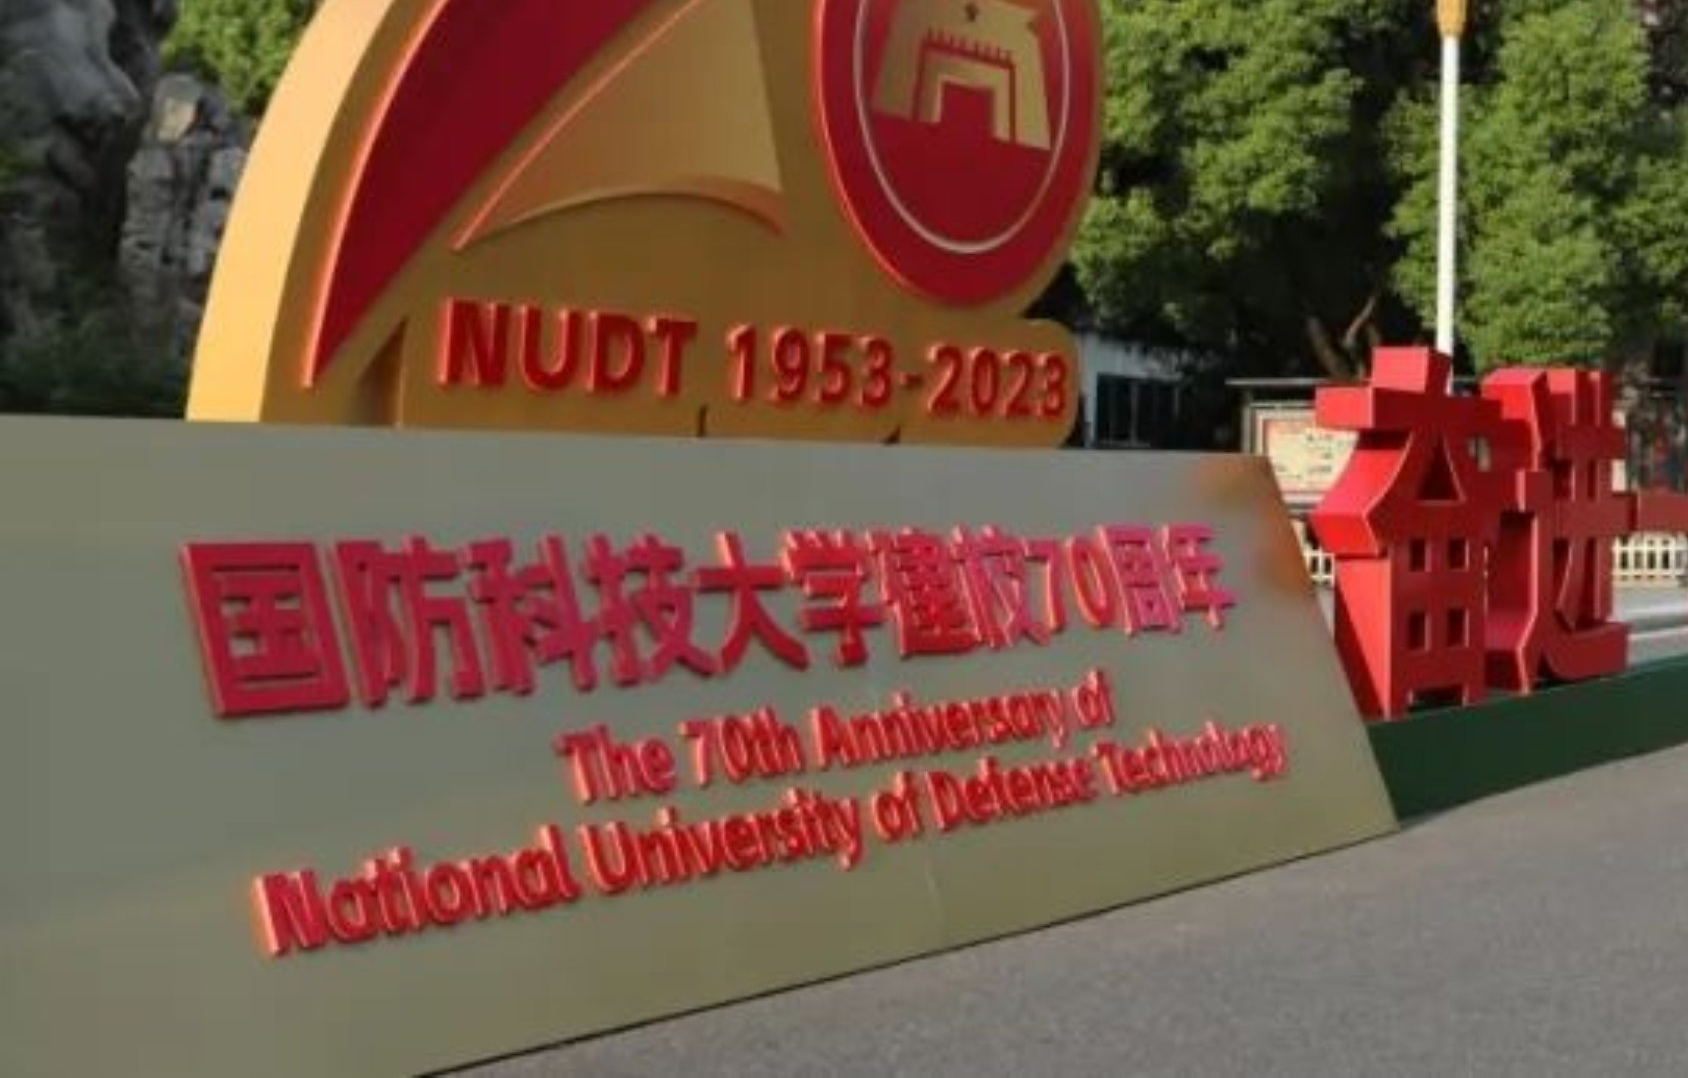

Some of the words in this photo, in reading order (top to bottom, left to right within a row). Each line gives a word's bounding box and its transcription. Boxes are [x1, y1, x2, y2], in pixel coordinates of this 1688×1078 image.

[438, 297, 698, 397] NUDT
[727, 323, 1069, 420] 1953-2023
[180, 524, 1235, 719] 国防科技大学建校70周年
[556, 722, 676, 804] The
[680, 706, 800, 787] 70th
[812, 680, 1068, 771] Anniversary
[1073, 670, 1116, 725] of
[251, 823, 583, 958] National
[578, 787, 864, 895] University
[870, 773, 921, 843] of
[925, 757, 1098, 832] Defense
[1096, 719, 1286, 797] Technology
